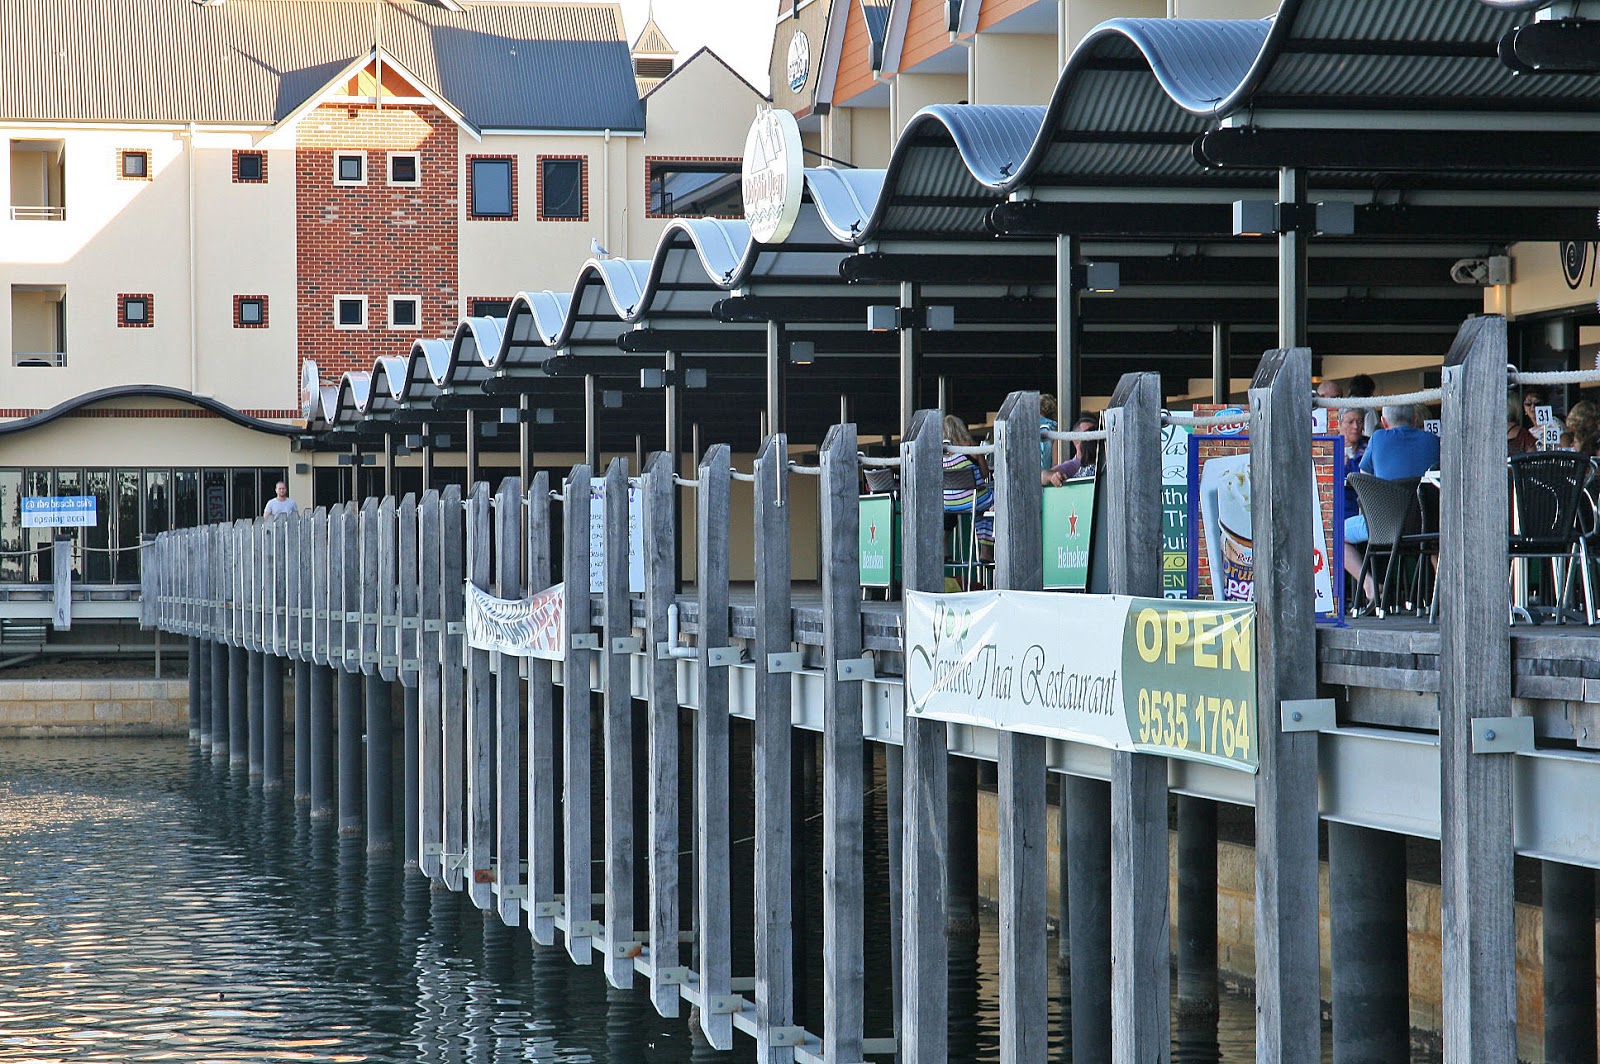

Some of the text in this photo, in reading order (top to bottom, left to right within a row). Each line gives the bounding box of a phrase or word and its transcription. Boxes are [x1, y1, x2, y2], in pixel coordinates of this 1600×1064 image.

[1538, 409, 1550, 422] 31
[1427, 422, 1438, 434] 35
[1546, 430, 1558, 441] 36
[34, 514, 85, 525] opening soon
[862, 550, 884, 569] Heineken
[1057, 546, 1089, 569] Heineken
[1135, 606, 1251, 672] OPEN
[909, 599, 1118, 717] Jasmine Thai Restaurant
[1137, 687, 1250, 759] 9535 1764
